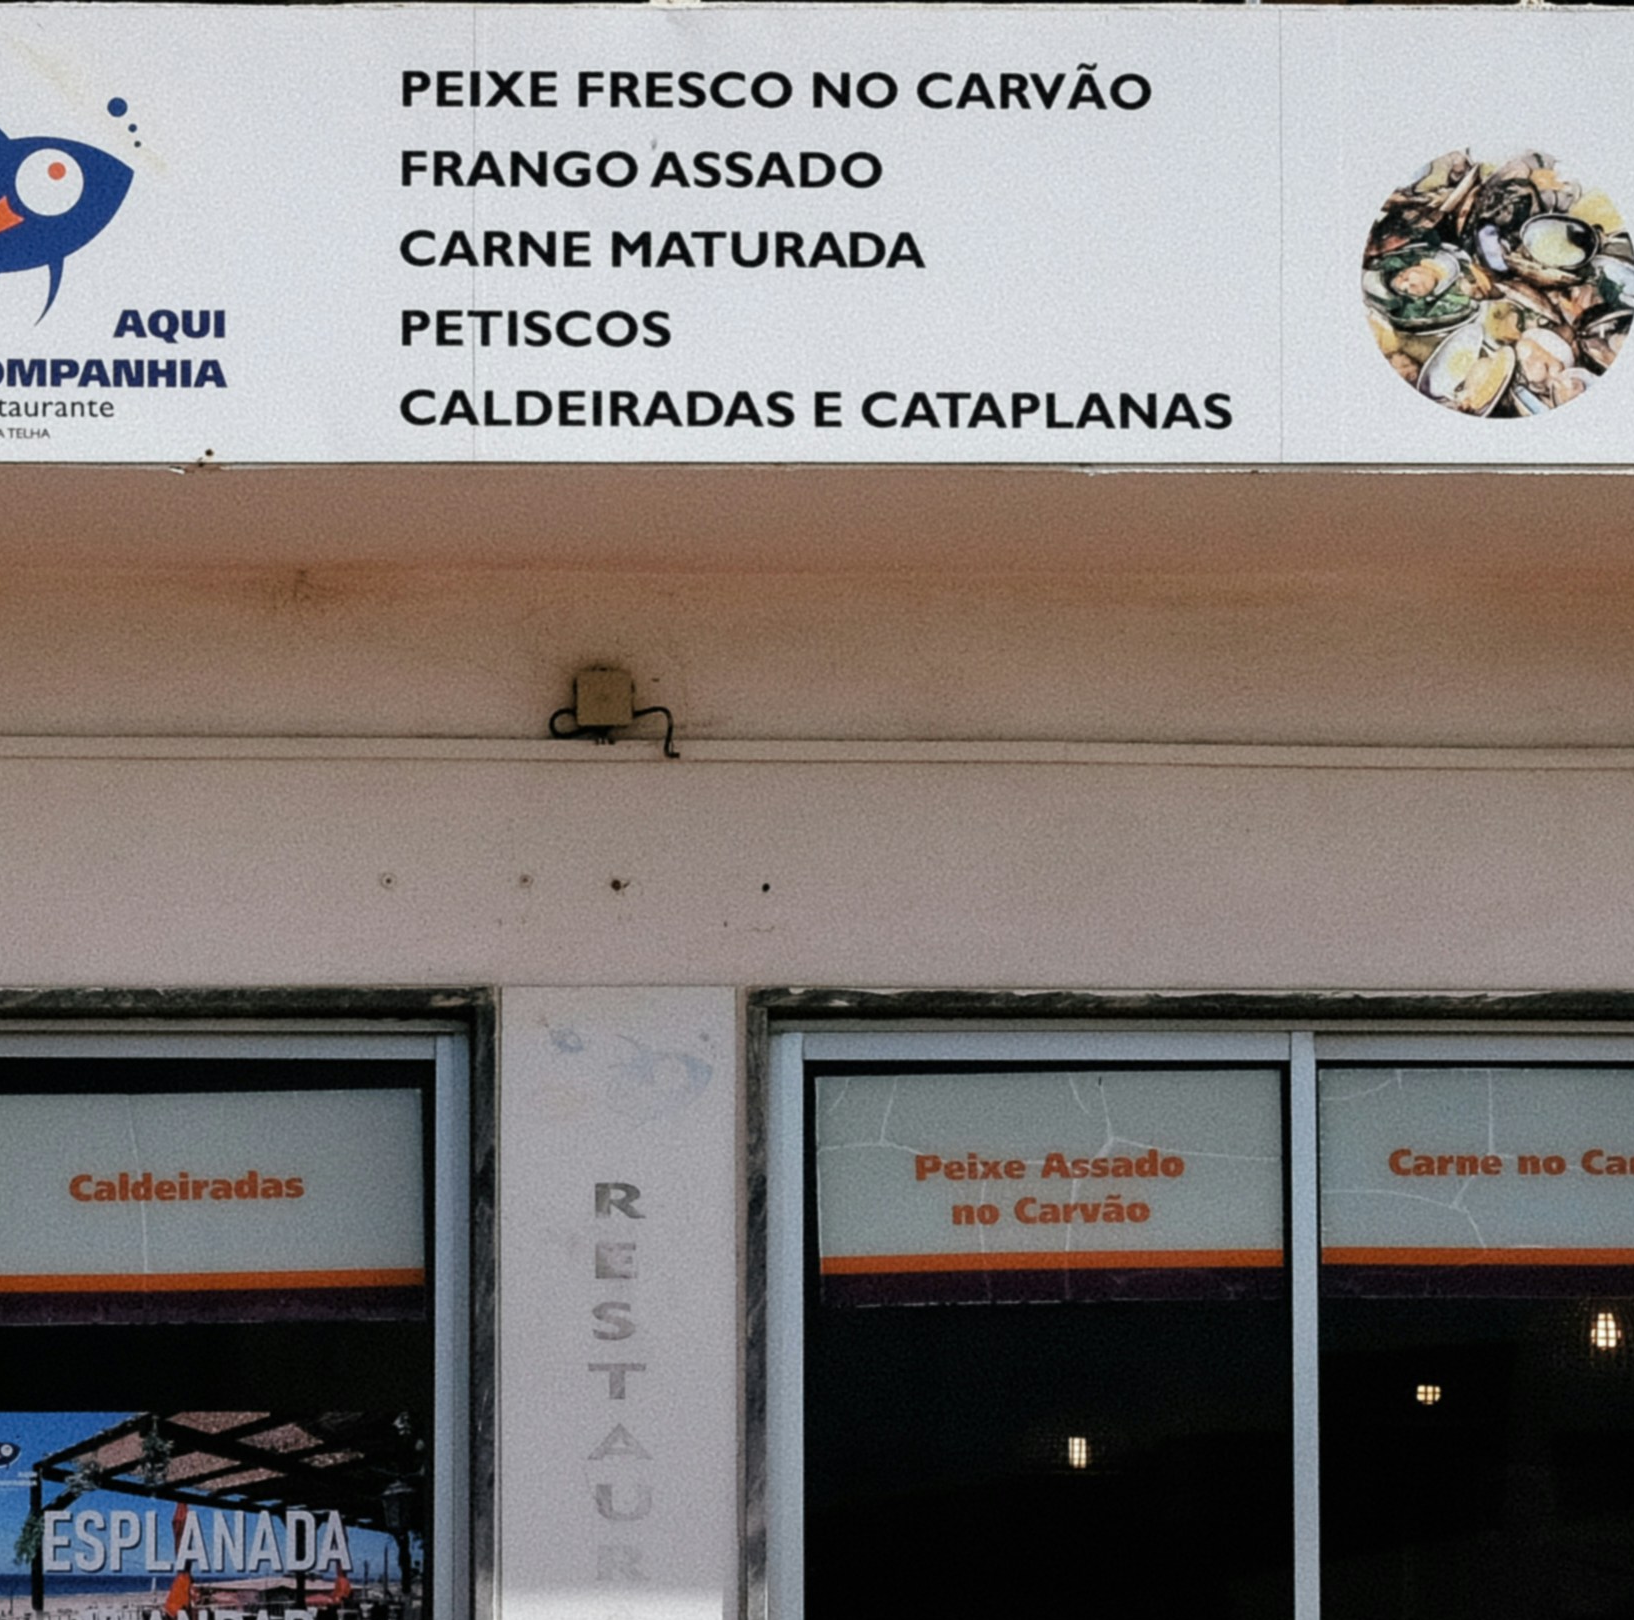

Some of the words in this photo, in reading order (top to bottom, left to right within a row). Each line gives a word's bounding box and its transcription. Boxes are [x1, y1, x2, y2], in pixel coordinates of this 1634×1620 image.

[403, 71, 557, 107] PEIXE
[579, 72, 792, 108] FRESCO
[813, 72, 897, 108] NO
[917, 63, 1151, 110] CARVÃO
[402, 151, 638, 187] FRANGO
[651, 151, 882, 188] ASSADO
[400, 230, 590, 267] CARNE
[612, 231, 925, 268] MATURADA
[114, 310, 225, 343] AQUI
[402, 310, 670, 347] PETISCOS
[400, 389, 794, 427] CALDEIRADAS
[815, 392, 841, 427] E
[862, 392, 1232, 429] CATAPLANAS
[8, 428, 50, 439] TELHA
[915, 1153, 1026, 1181] Peixe
[1041, 1149, 1184, 1178] Assado
[1389, 1149, 1502, 1176] Carne
[1518, 1155, 1566, 1175] no
[69, 1171, 304, 1202] Caldeiradas
[952, 1204, 1000, 1225] no
[1014, 1194, 1150, 1224] Carvão
[44, 1508, 352, 1575] ESPLANADA
